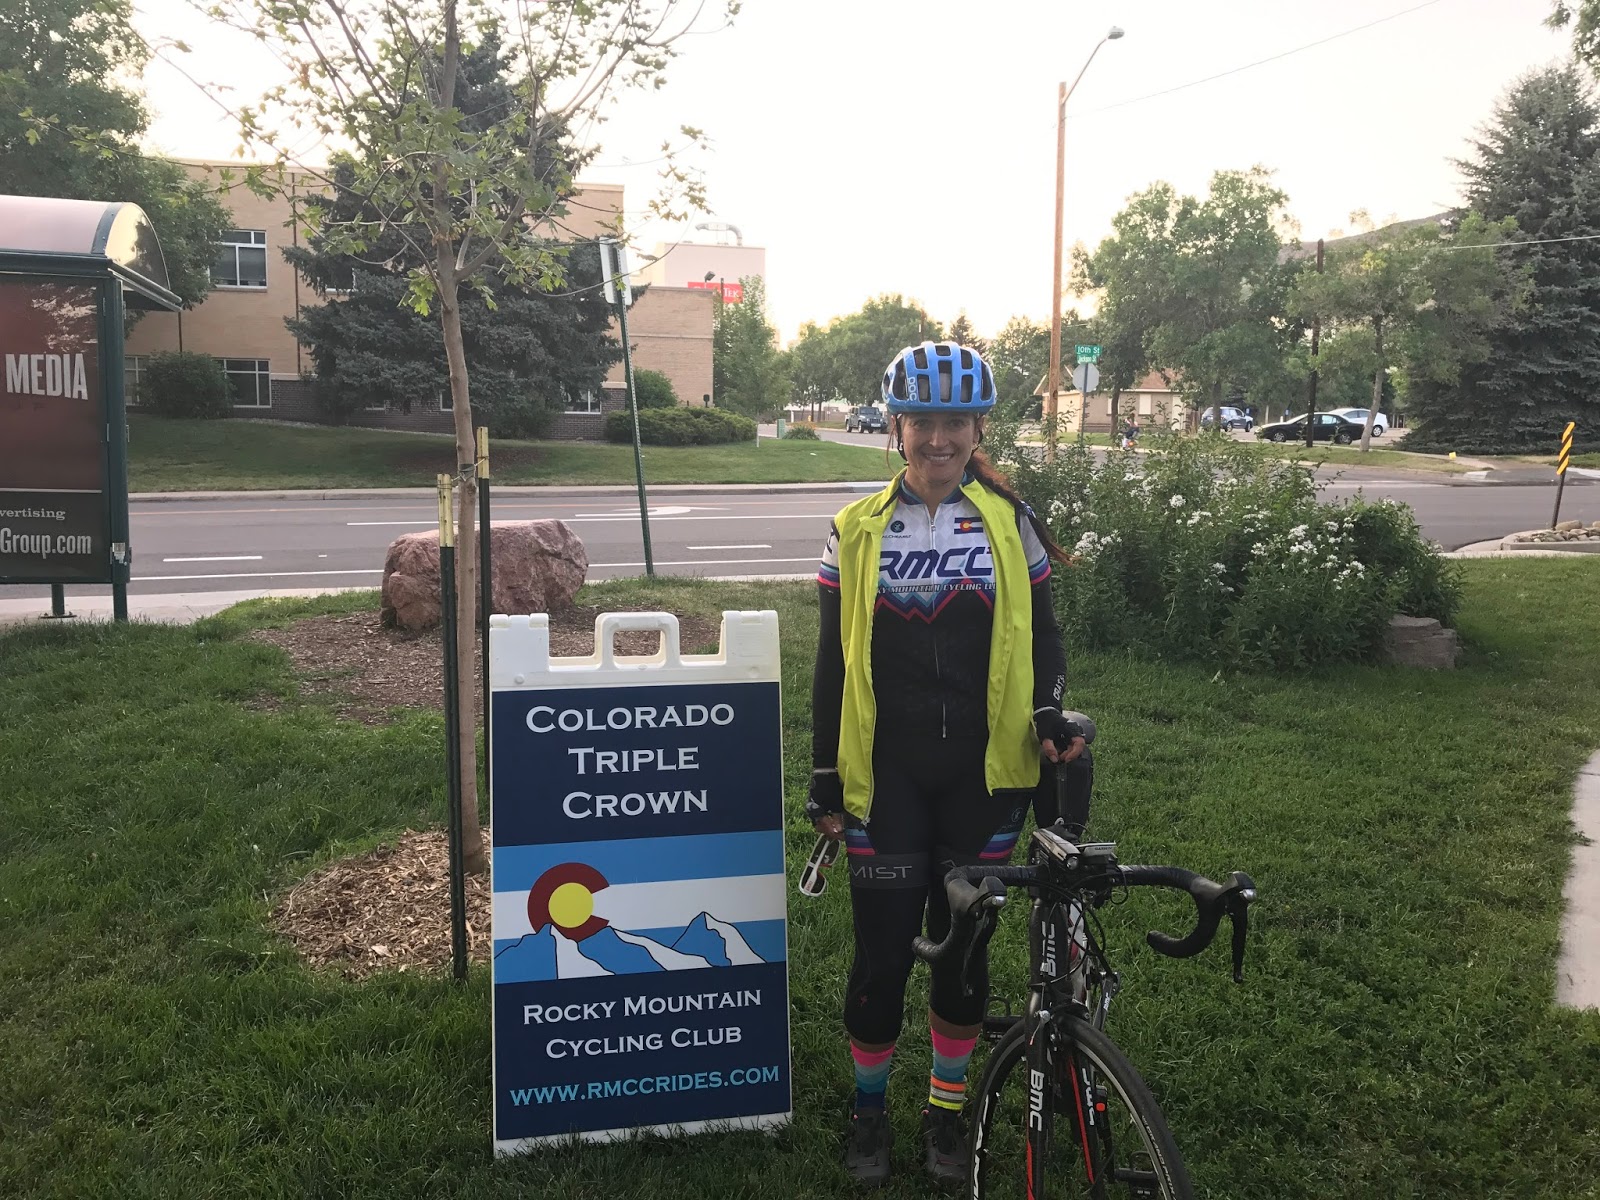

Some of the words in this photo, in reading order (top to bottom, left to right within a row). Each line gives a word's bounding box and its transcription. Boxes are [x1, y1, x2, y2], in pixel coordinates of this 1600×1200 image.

[1077, 346, 1092, 354] 10th
[1093, 346, 1100, 354] St
[5, 353, 88, 400] MEDIA
[0, 508, 66, 520] vertising
[0, 527, 92, 559] Group.com
[879, 546, 992, 580] RMCC
[943, 583, 981, 591] CYCLING
[525, 703, 735, 733] COLORADO
[567, 746, 700, 775] TRIPLE
[562, 789, 708, 819] CROWN
[523, 1000, 617, 1025] ROCKY
[623, 989, 762, 1017] MOUNTAIN
[546, 1032, 663, 1059] CYCLING
[670, 1026, 742, 1048] CLUB
[509, 1065, 780, 1107] WWW.RMCCRIDES.COM
[1029, 1068, 1045, 1132] BMC
